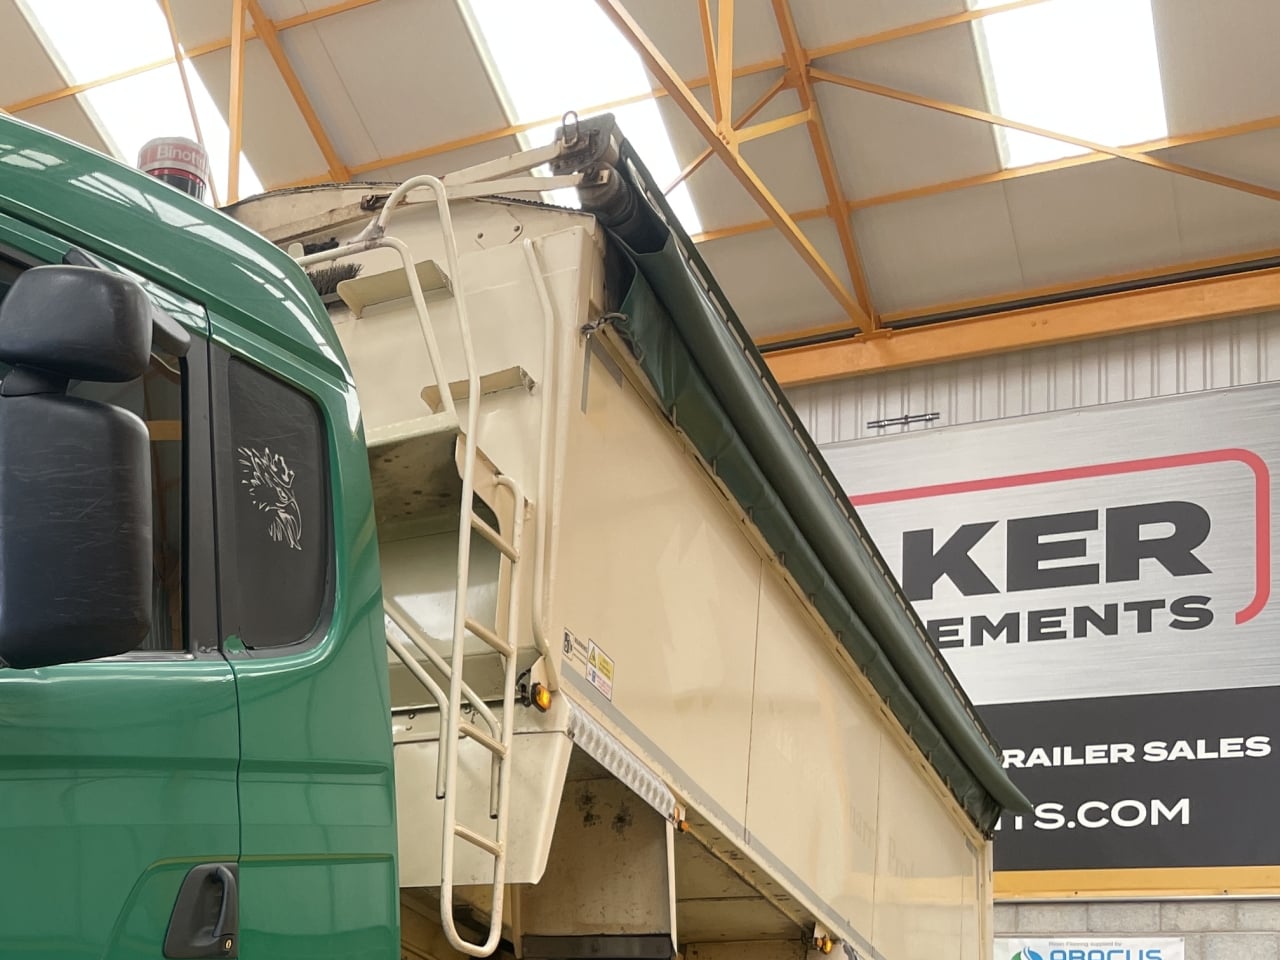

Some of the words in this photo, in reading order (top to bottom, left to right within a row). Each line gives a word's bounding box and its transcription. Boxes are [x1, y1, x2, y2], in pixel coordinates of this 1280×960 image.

[927, 595, 1214, 649] EMENTS
[1002, 743, 1135, 769] RAILER
[1143, 736, 1271, 762] SALES
